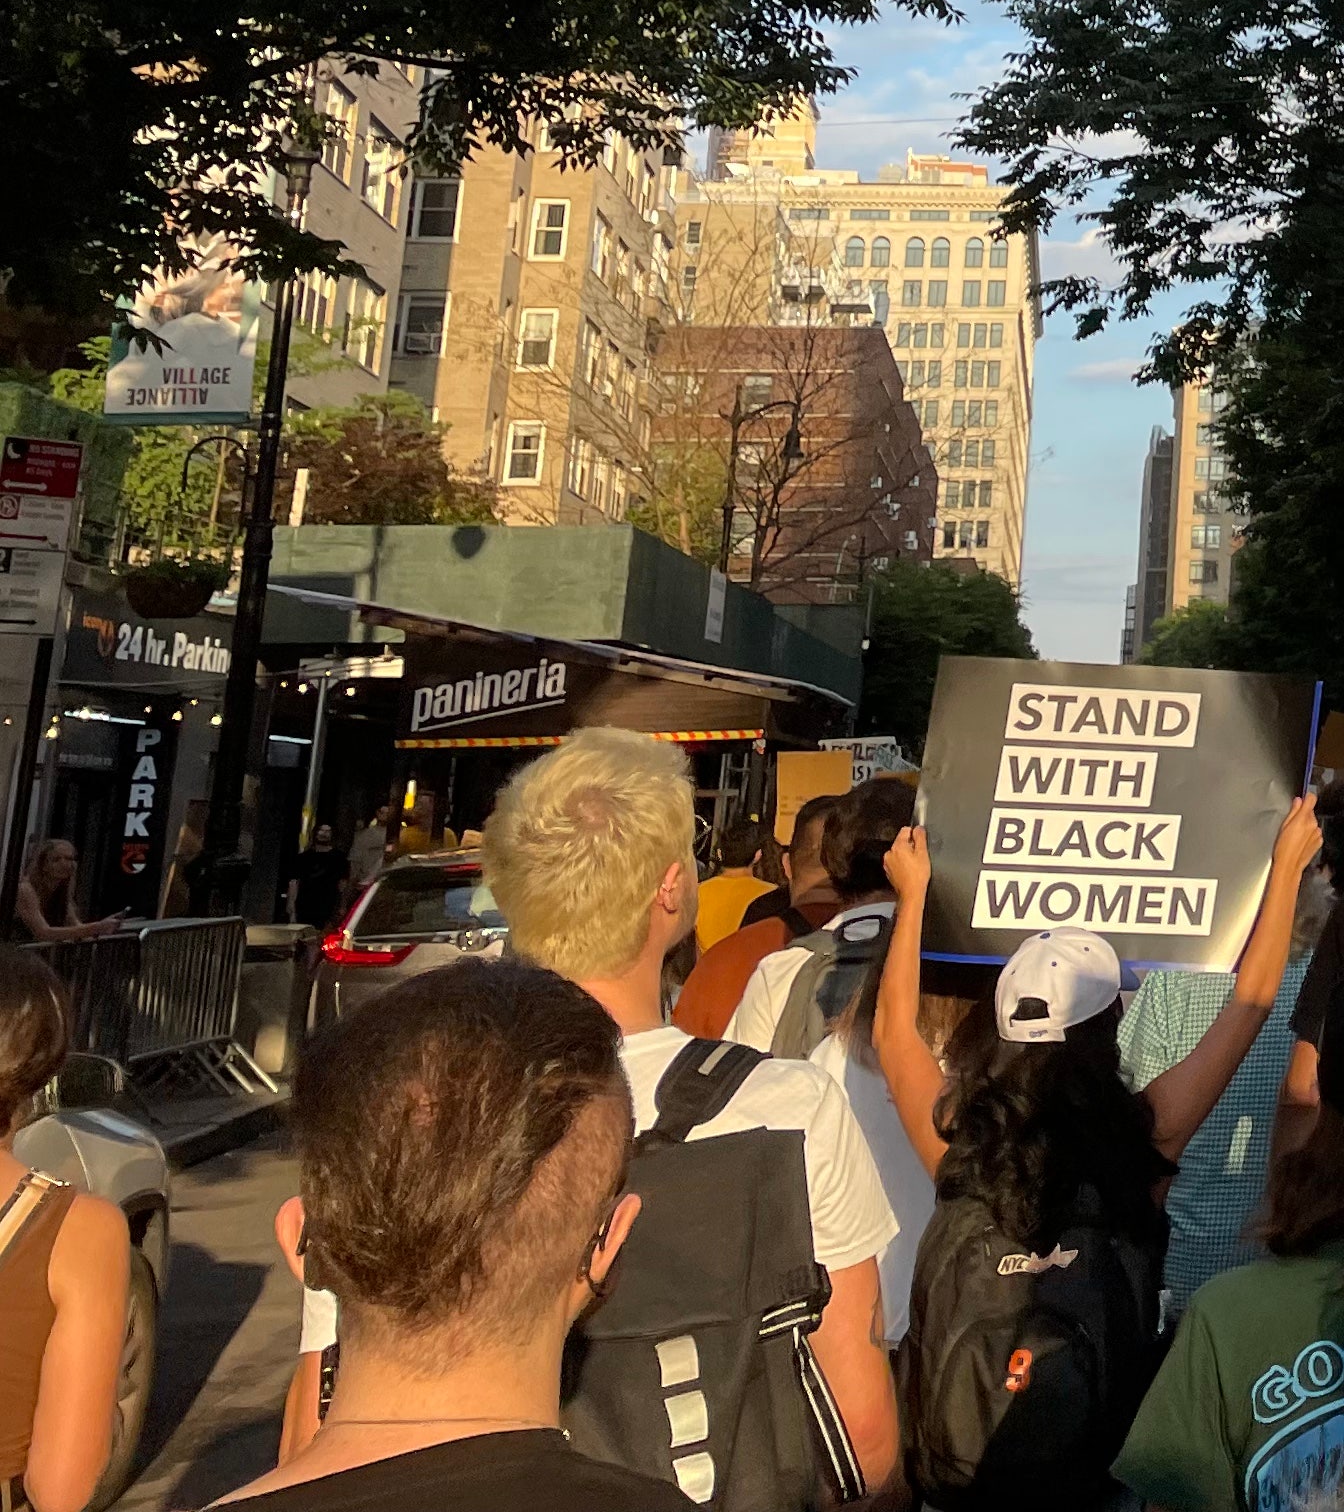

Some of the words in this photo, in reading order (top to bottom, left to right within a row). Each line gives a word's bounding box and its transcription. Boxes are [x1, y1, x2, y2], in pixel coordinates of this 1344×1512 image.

[126, 388, 209, 406] ALLIANCE
[162, 367, 232, 385] VILLAGE
[115, 622, 144, 662] 24
[145, 628, 169, 666] hr.
[171, 631, 231, 674] Parkin
[410, 658, 567, 732] panineria
[1013, 692, 1191, 738] STAND
[124, 729, 161, 837] PARK
[1008, 755, 1147, 798] WITH
[992, 816, 1171, 861] BLACK
[985, 879, 1207, 926] WOMEN
